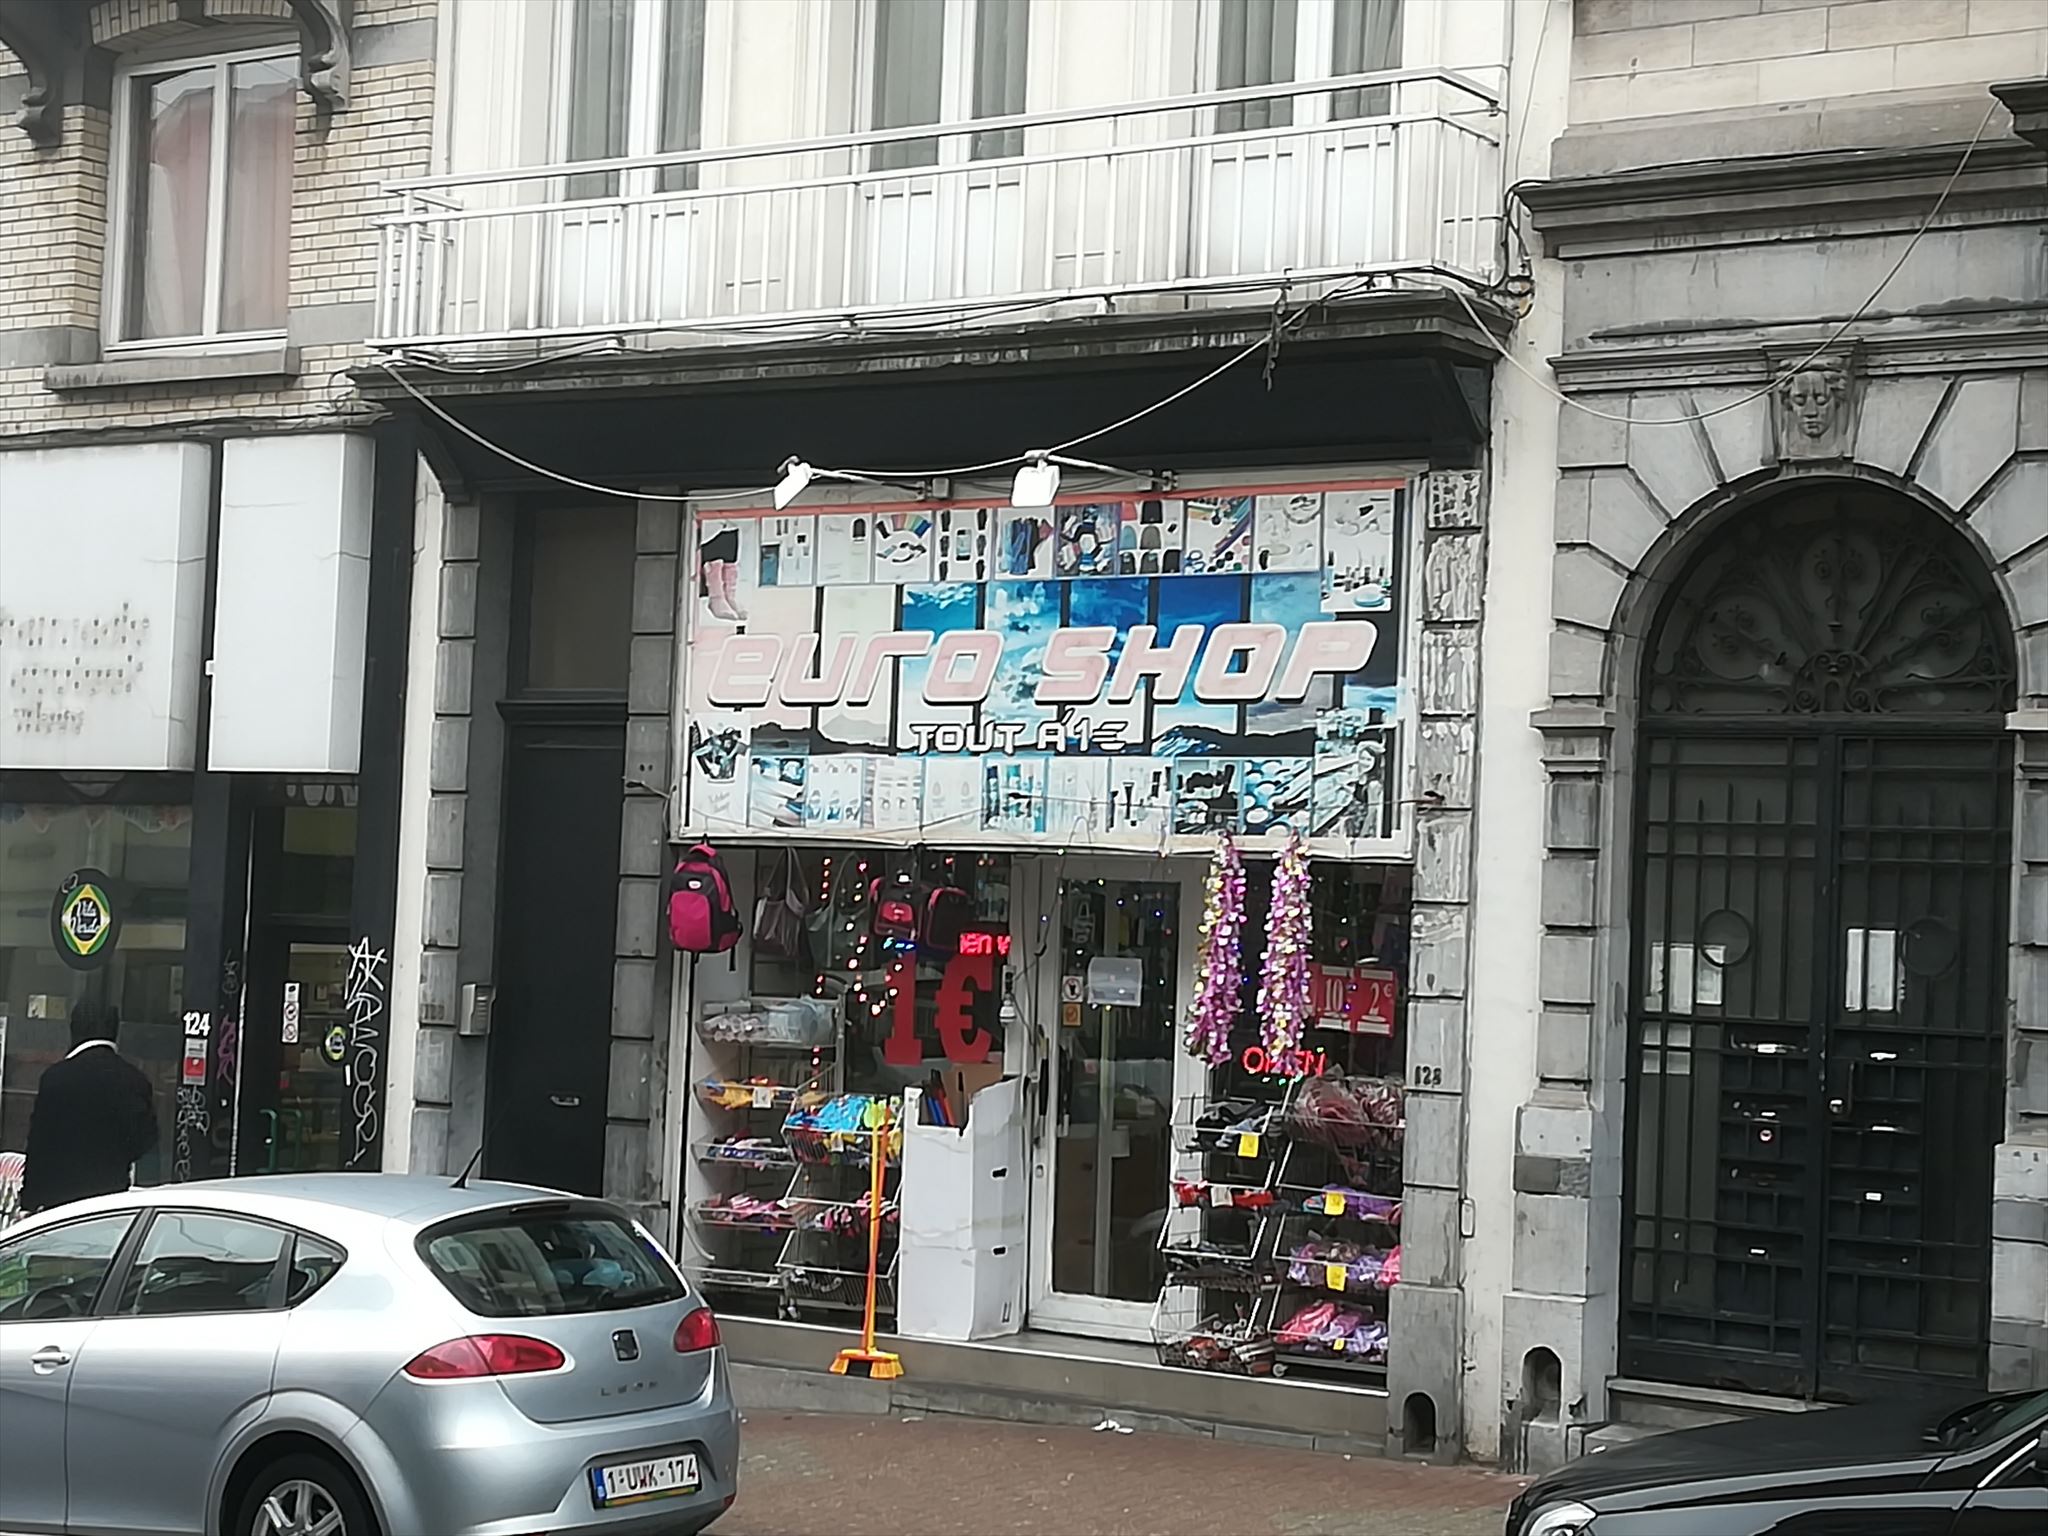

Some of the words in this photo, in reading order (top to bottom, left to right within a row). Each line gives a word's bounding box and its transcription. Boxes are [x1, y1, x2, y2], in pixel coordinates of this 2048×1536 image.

[1032, 621, 1379, 706] SHOP
[909, 719, 1028, 755] TOUT
[182, 1011, 211, 1037] 124
[1242, 1046, 1327, 1077] ON
